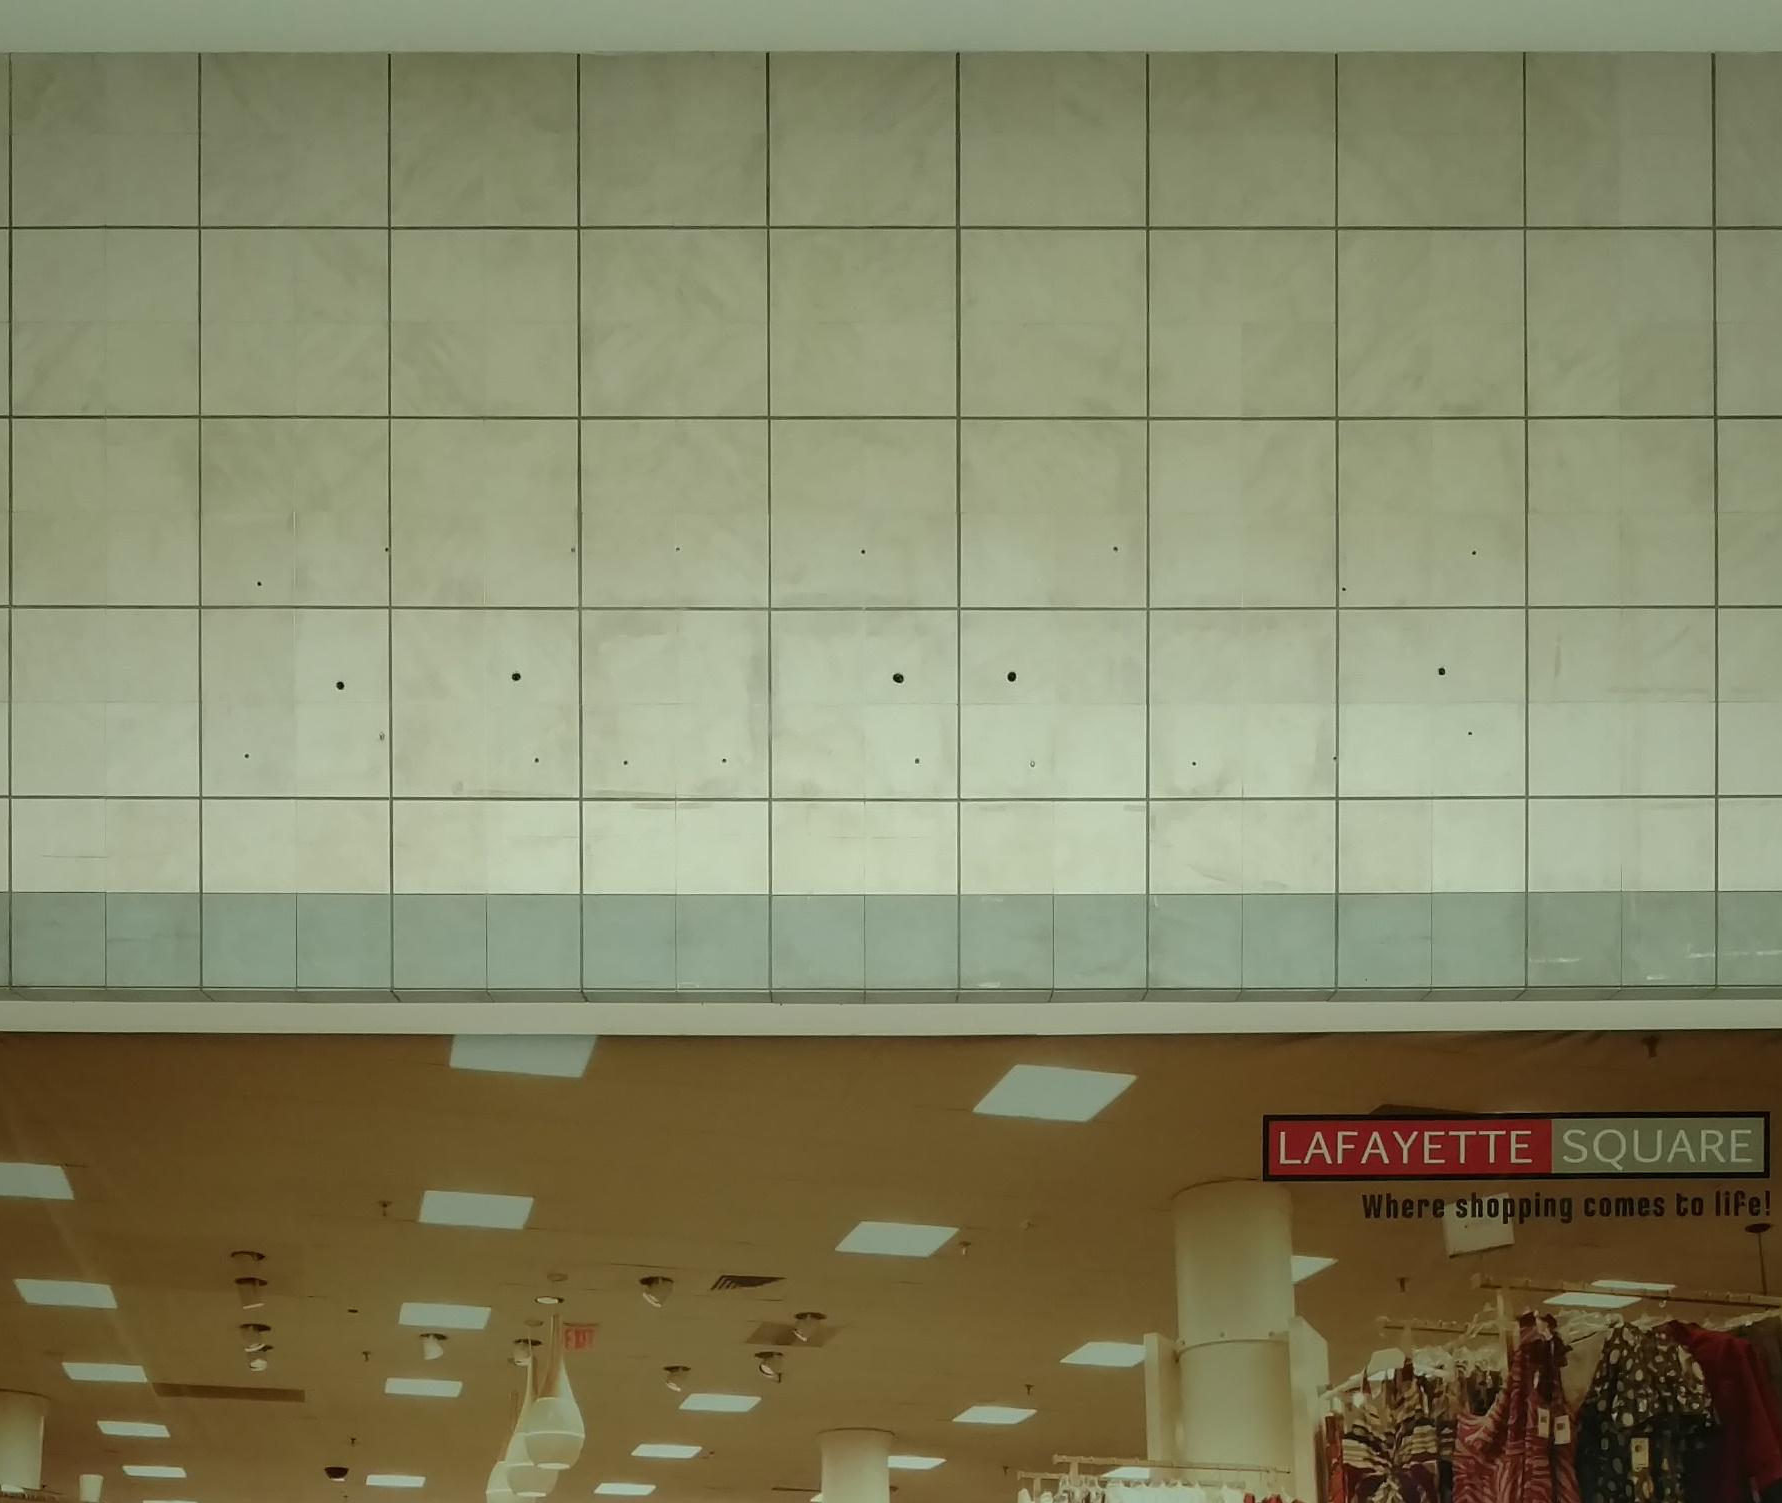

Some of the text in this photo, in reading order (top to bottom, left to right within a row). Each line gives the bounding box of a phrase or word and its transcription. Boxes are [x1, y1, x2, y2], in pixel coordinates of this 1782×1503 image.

[1278, 1127, 1753, 1171] LAFAYETTE SQUARE
[1361, 1190, 1772, 1224] Where shopping comes to life!
